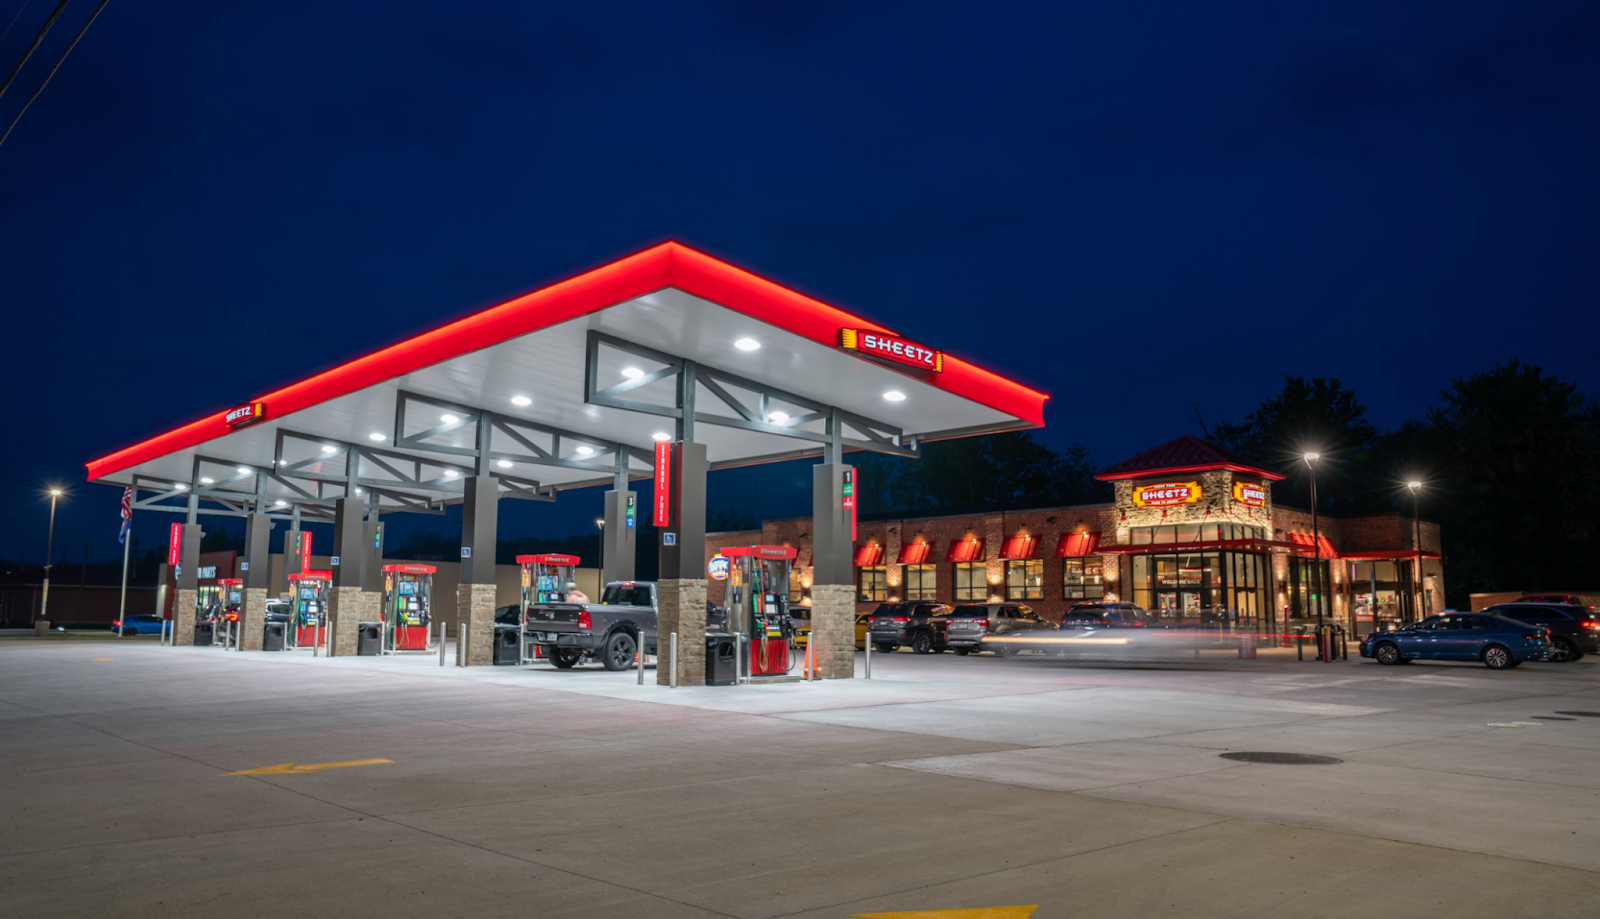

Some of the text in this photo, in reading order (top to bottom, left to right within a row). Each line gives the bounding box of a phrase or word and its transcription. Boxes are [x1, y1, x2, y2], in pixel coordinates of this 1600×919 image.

[864, 334, 933, 364] SHEETZ
[226, 406, 251, 422] SHEETZ
[846, 472, 850, 482] 1
[1142, 488, 1188, 500] SHEETZ
